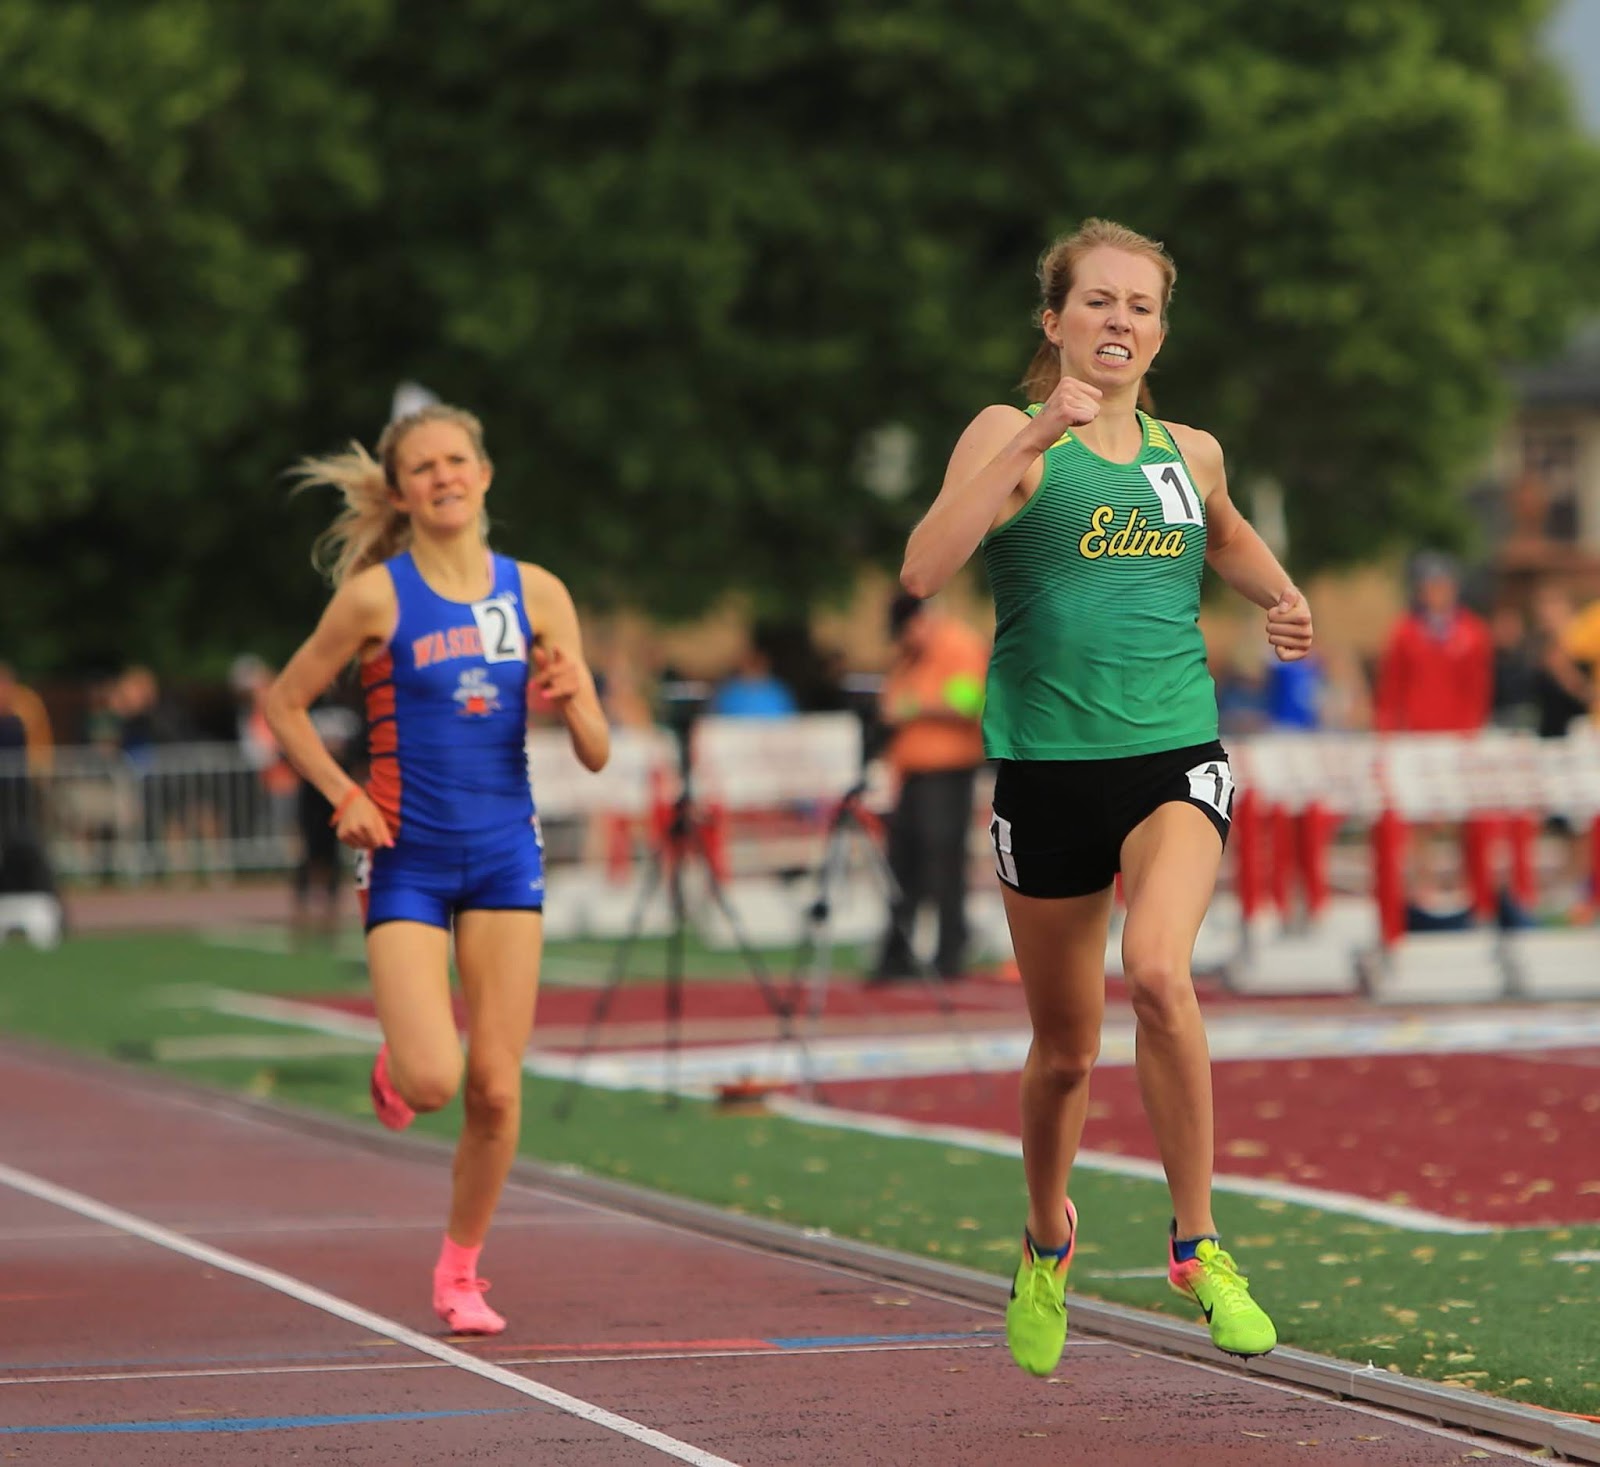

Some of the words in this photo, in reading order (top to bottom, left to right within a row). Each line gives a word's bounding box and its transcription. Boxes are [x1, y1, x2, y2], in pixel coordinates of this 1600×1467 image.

[1161, 467, 1194, 519] 1
[1078, 505, 1186, 560] Edina
[412, 625, 484, 669] WASH
[486, 606, 515, 653] 2
[1203, 763, 1224, 807] 1
[991, 820, 1008, 877] 1
